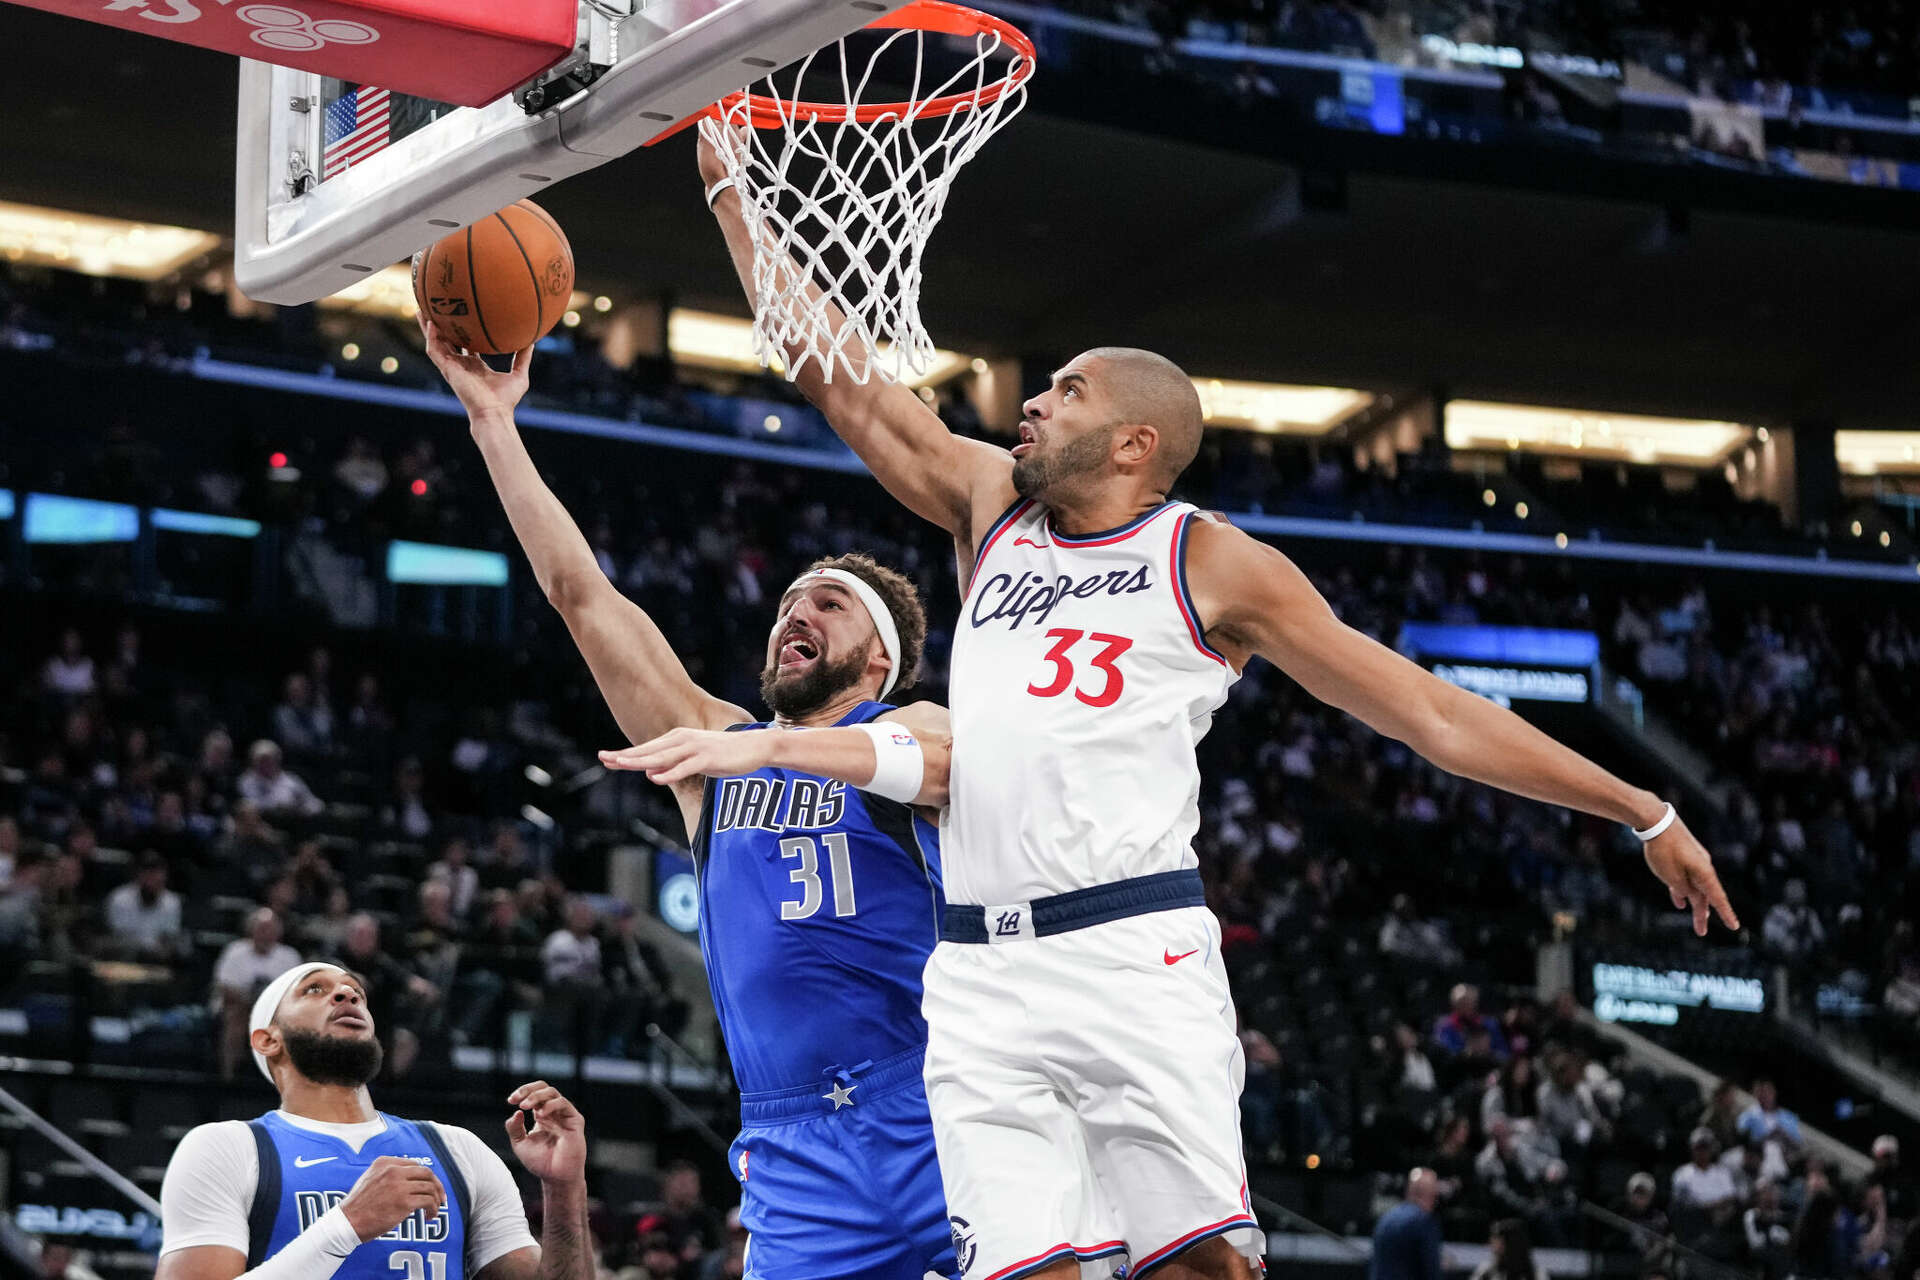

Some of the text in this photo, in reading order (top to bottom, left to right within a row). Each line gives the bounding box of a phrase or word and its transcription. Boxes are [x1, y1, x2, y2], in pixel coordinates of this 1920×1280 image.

[972, 565, 1153, 630] Clippers
[1027, 628, 1134, 708] 33
[779, 832, 857, 920] 31
[996, 911, 1021, 936] LA
